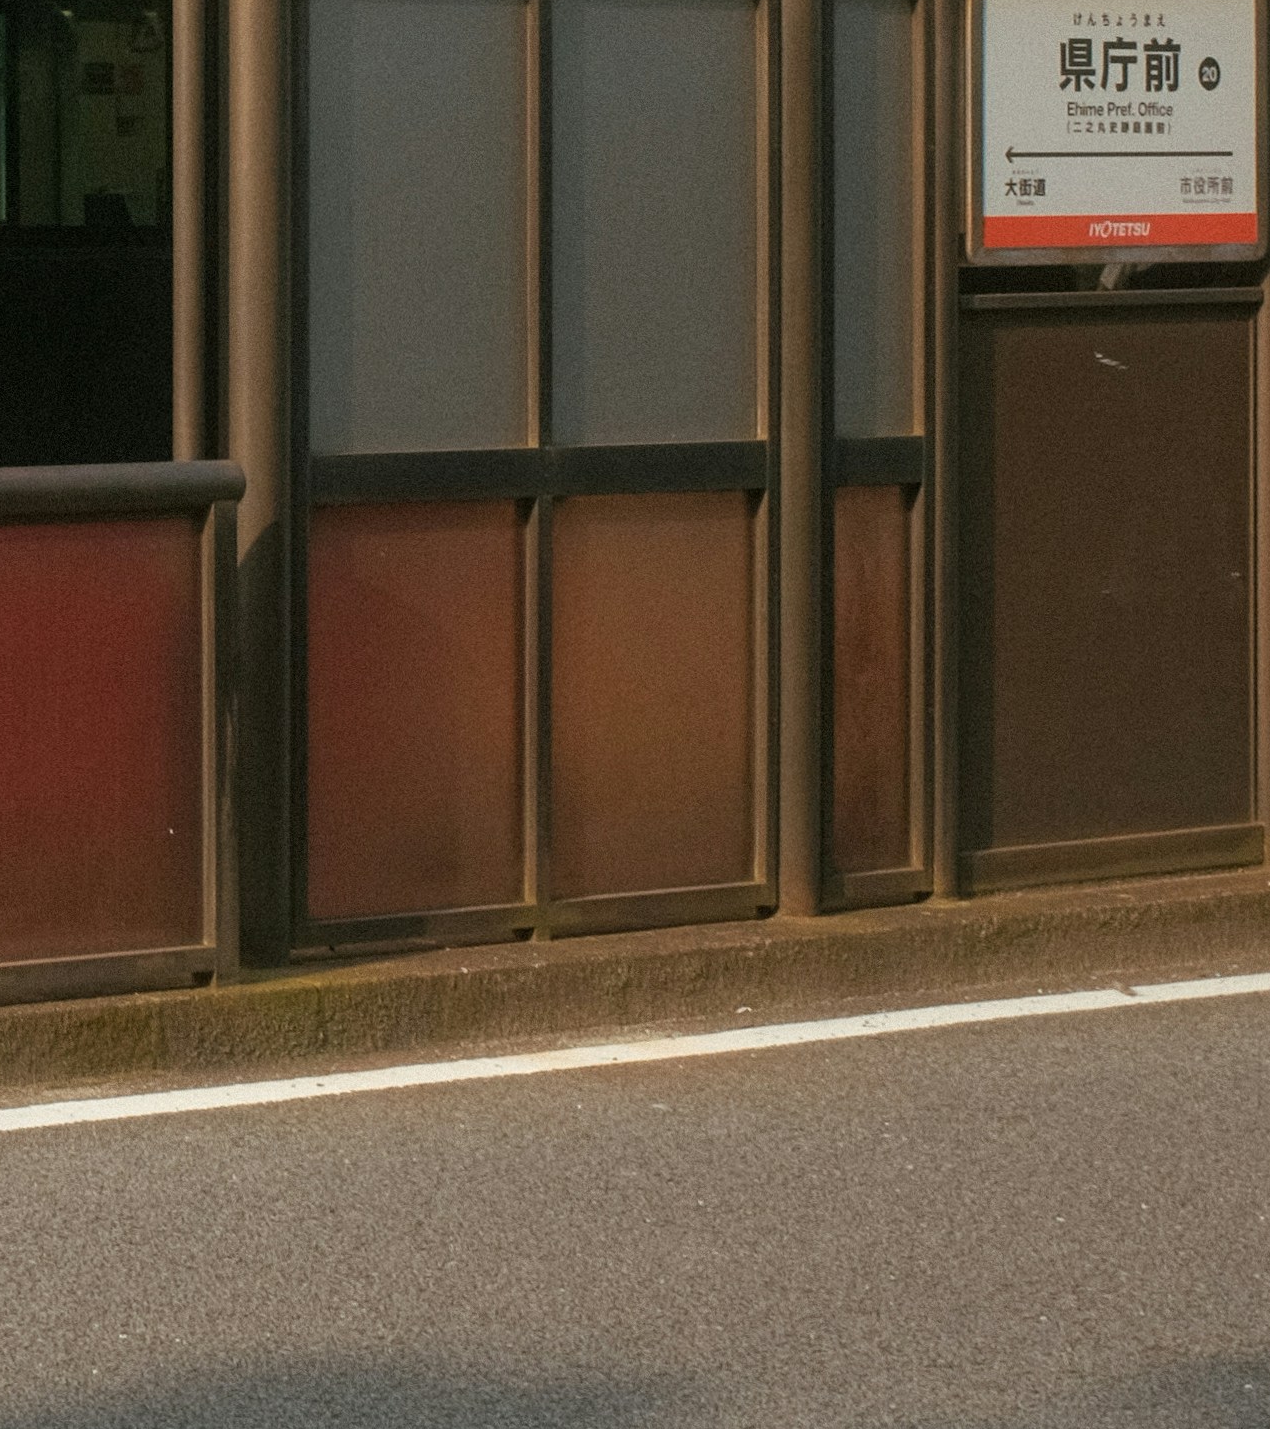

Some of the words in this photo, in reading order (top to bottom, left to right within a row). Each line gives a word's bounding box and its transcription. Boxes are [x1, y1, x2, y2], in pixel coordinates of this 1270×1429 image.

[1073, 13, 1165, 27] けんちょうまえ
[1059, 37, 1181, 92] 県庁前
[1202, 66, 1217, 82] 20
[1067, 102, 1104, 117] Ehime
[1107, 102, 1135, 117] Pref.
[1138, 102, 1173, 117] Office
[1004, 178, 1046, 197] 大街道
[1179, 177, 1234, 196] 市役所前
[1089, 220, 1151, 239] IYOTETSU
